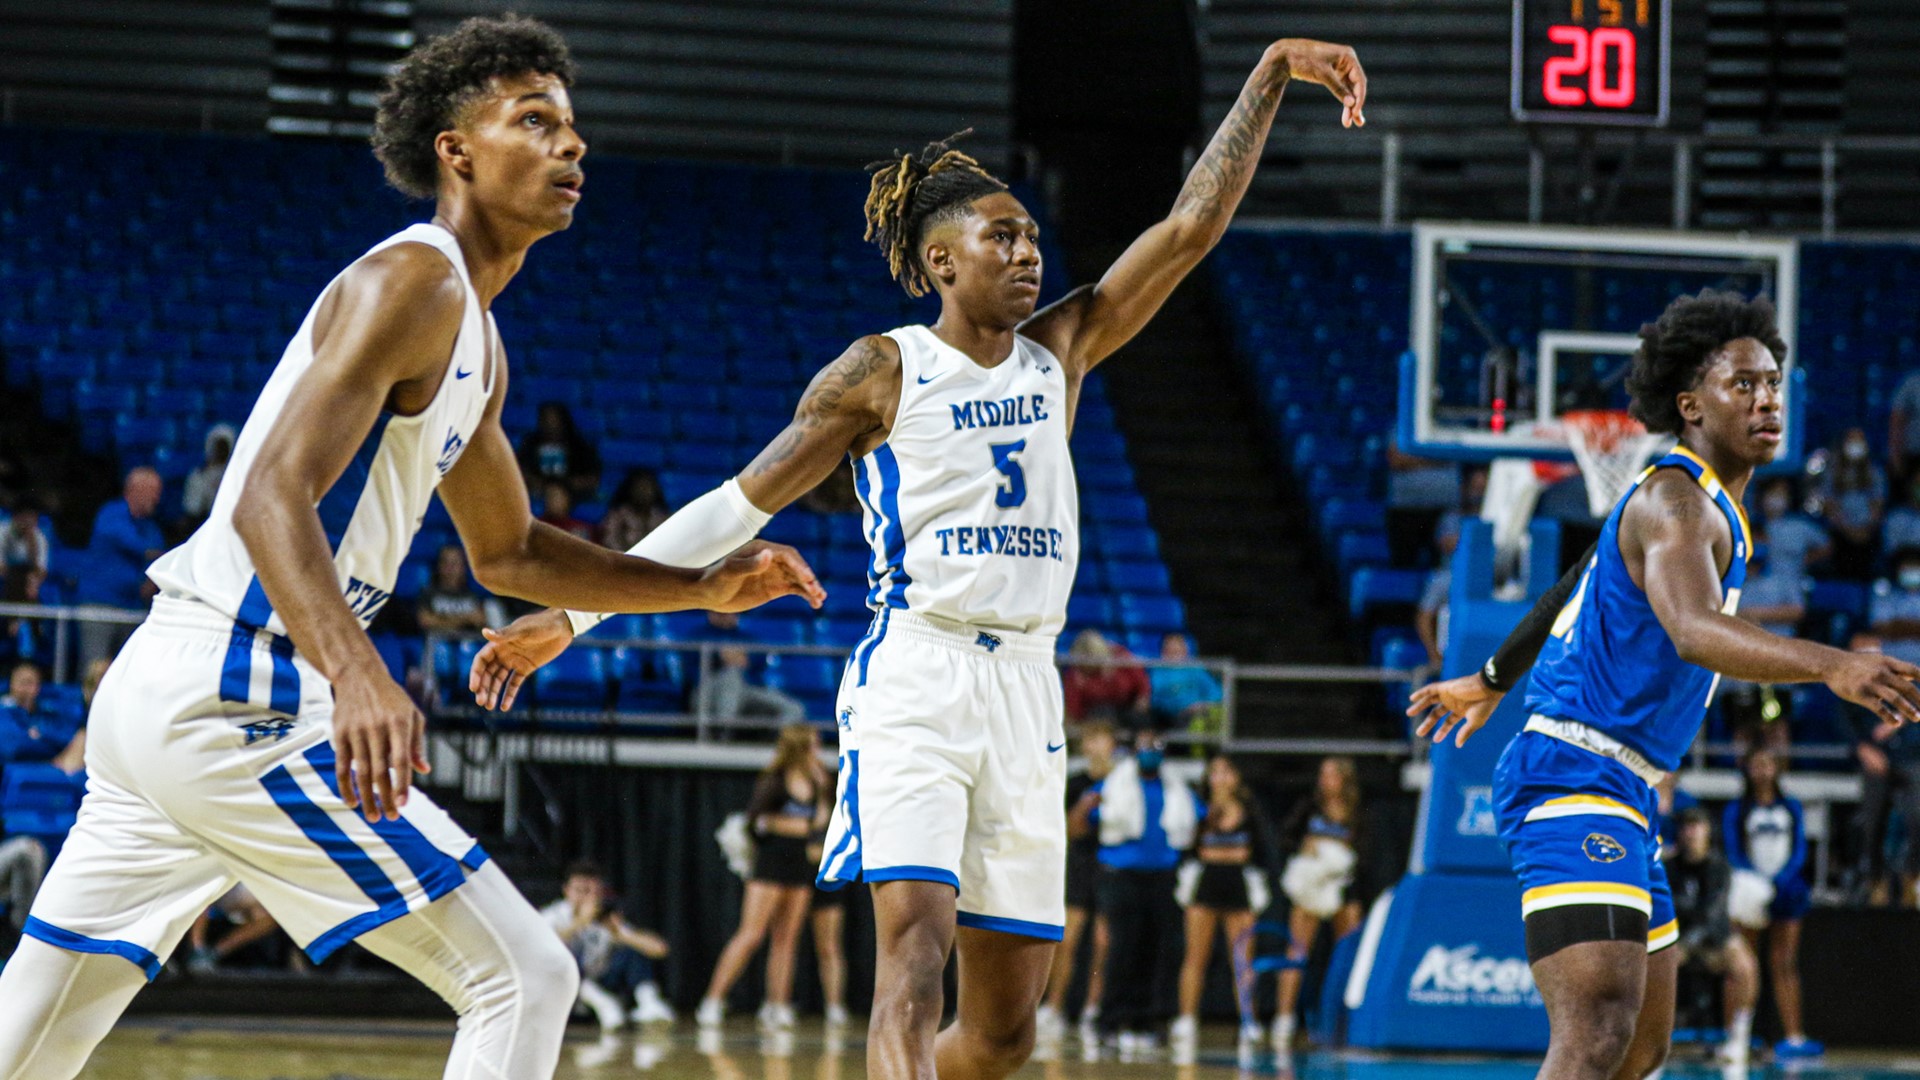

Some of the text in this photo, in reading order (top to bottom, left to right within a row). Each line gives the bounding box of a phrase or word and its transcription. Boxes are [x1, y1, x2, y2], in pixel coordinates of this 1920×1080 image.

[1543, 26, 1636, 108] 20
[950, 394, 1048, 430] MIDDLE
[988, 438, 1027, 511] 5
